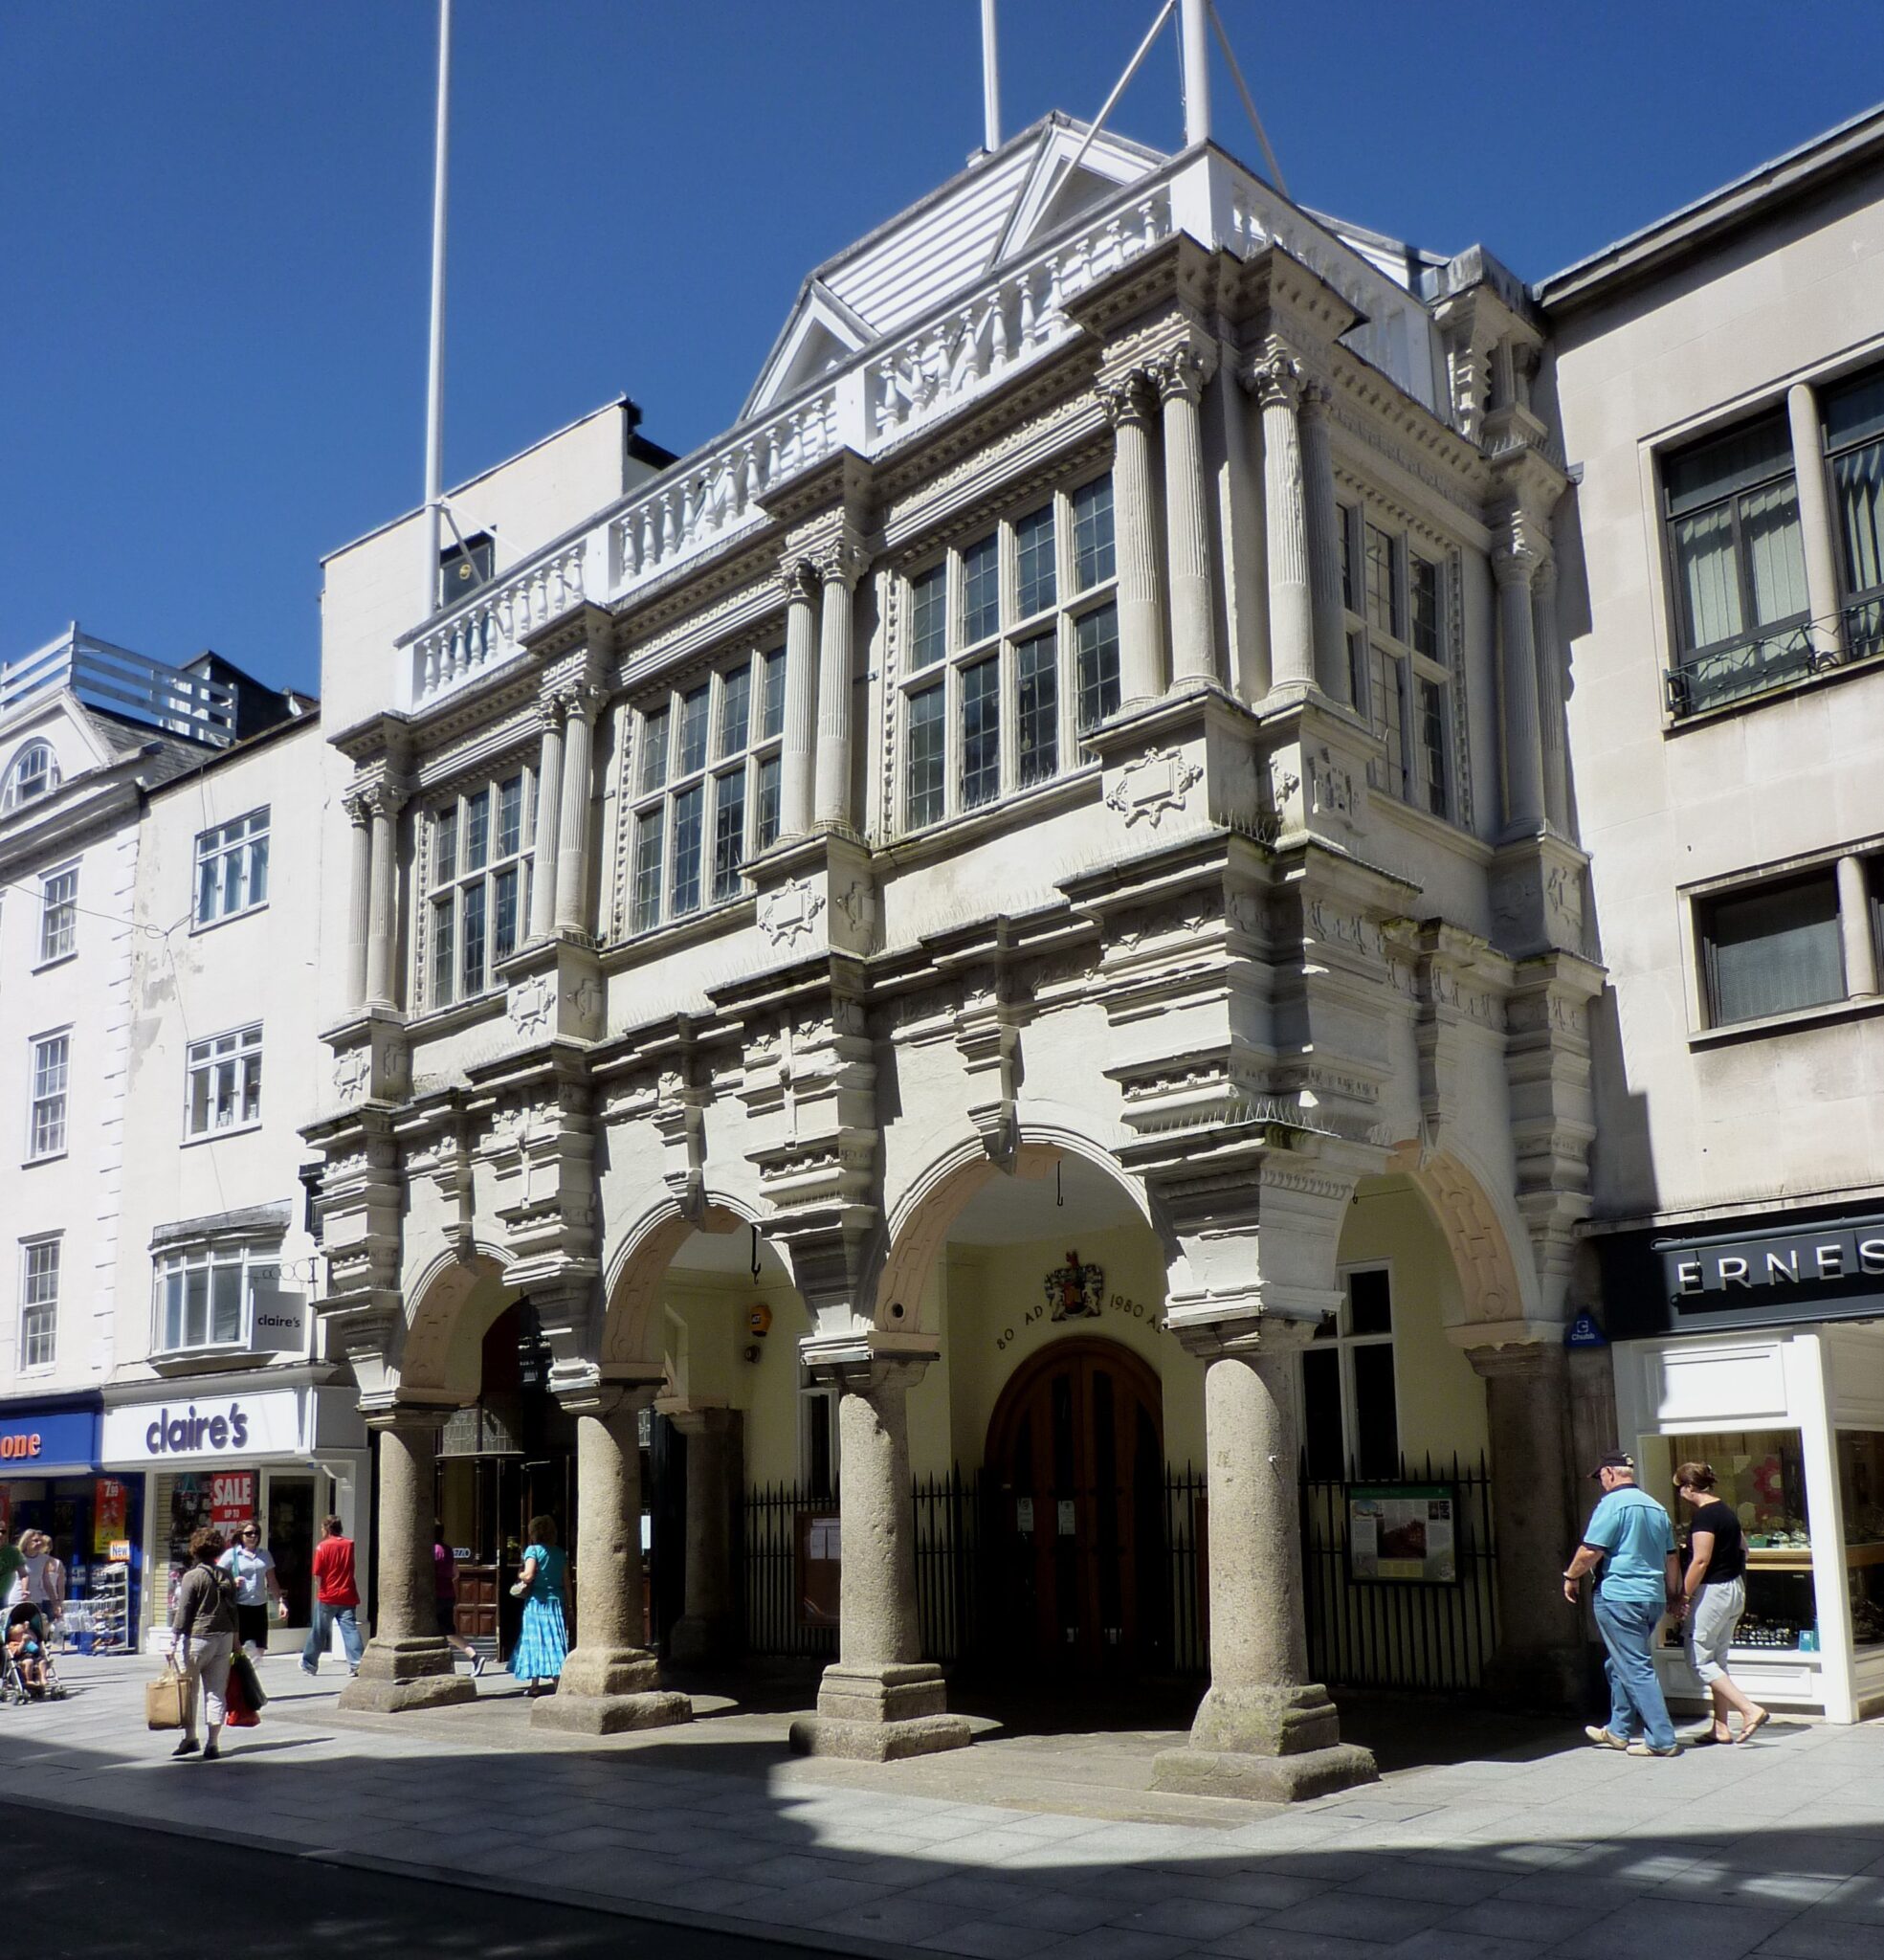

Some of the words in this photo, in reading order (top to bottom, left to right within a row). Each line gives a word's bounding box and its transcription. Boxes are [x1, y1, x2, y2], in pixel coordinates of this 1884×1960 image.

[1677, 1239, 1884, 1295] ERNES
[257, 1314, 300, 1328] claire's
[997, 1327, 1014, 1349] 80
[1025, 1305, 1043, 1325] AD
[1110, 1293, 1144, 1318] 1980
[145, 1402, 249, 1455] claire's
[213, 1477, 251, 1506] SALE
